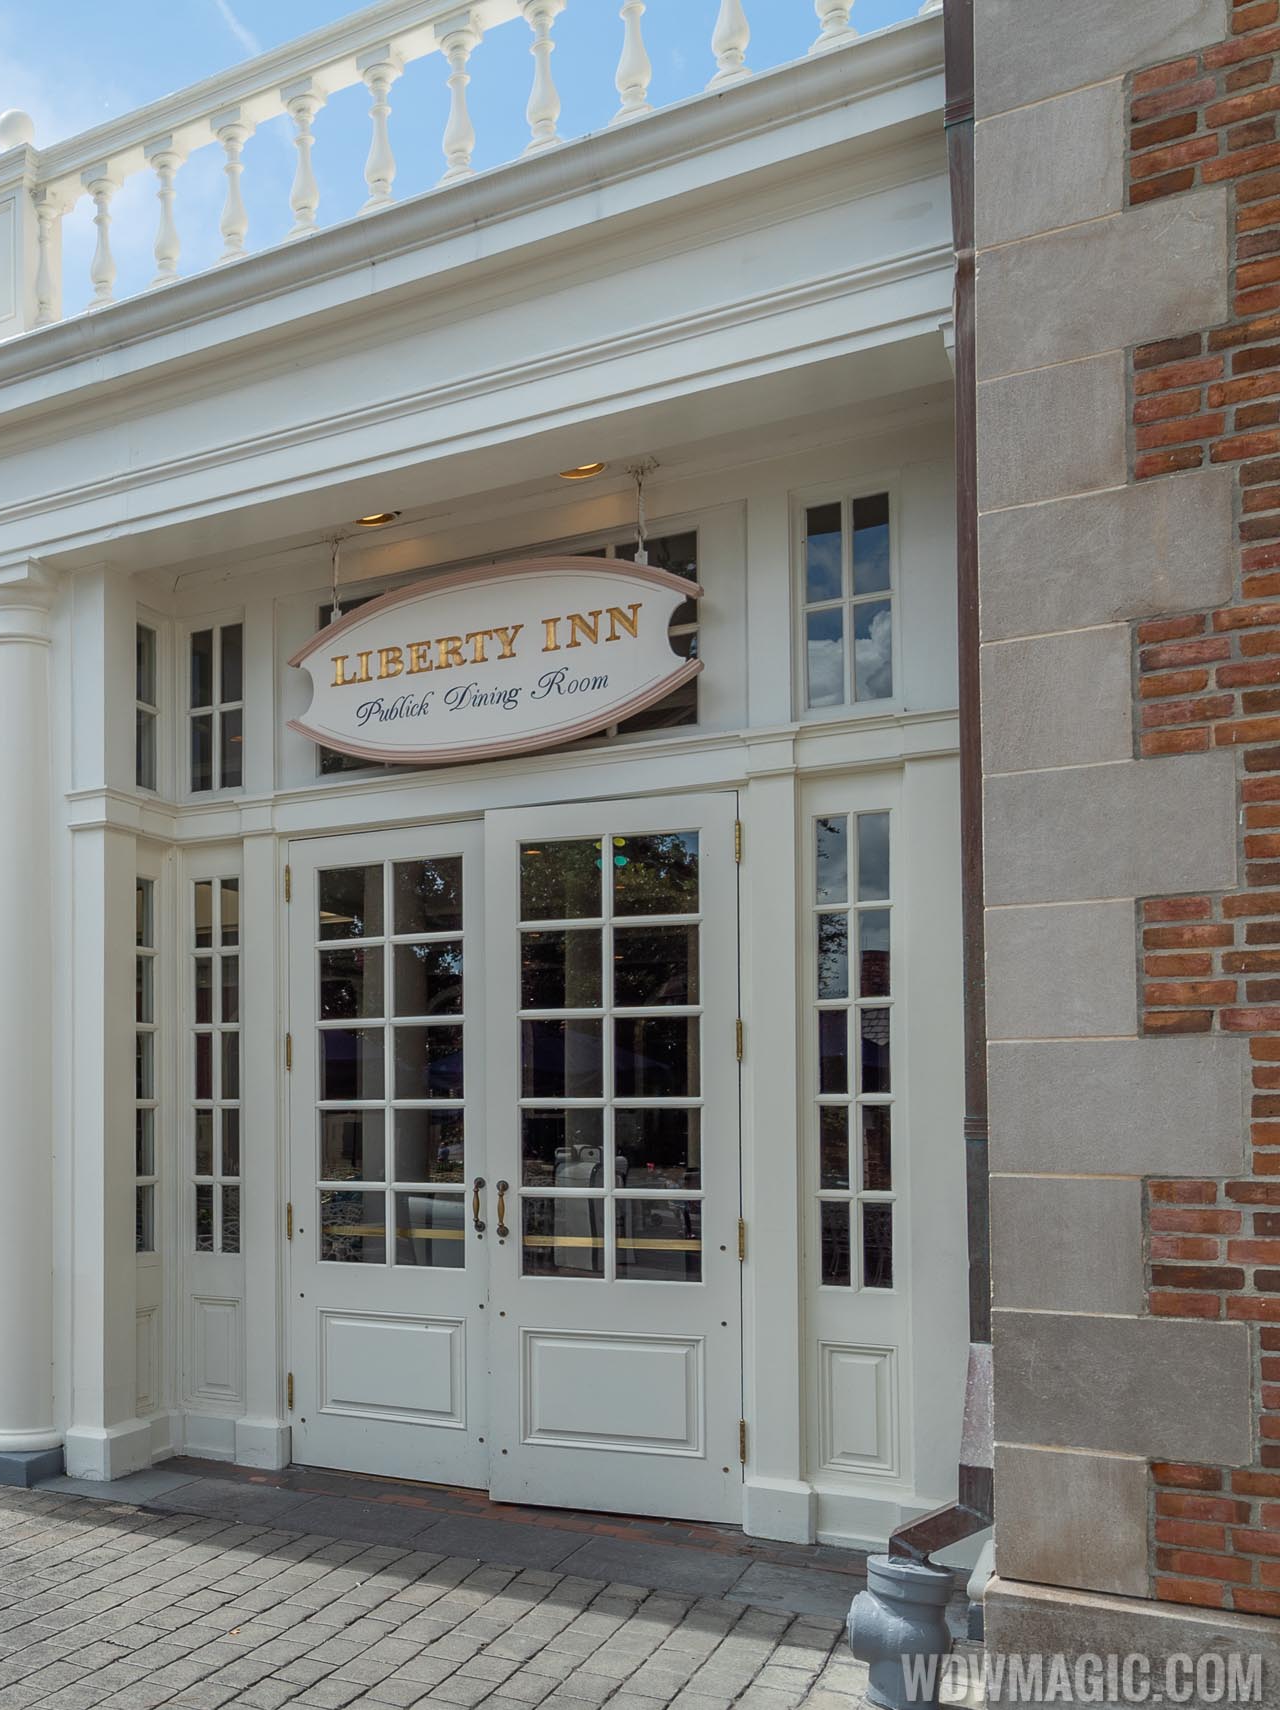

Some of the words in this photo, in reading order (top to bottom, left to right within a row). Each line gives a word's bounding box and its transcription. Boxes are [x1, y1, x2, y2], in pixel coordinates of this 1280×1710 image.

[330, 623, 524, 688] LIBERTY
[541, 602, 643, 653] INN
[356, 690, 435, 727] Publick
[443, 682, 522, 712] Dining
[530, 666, 609, 700] Room
